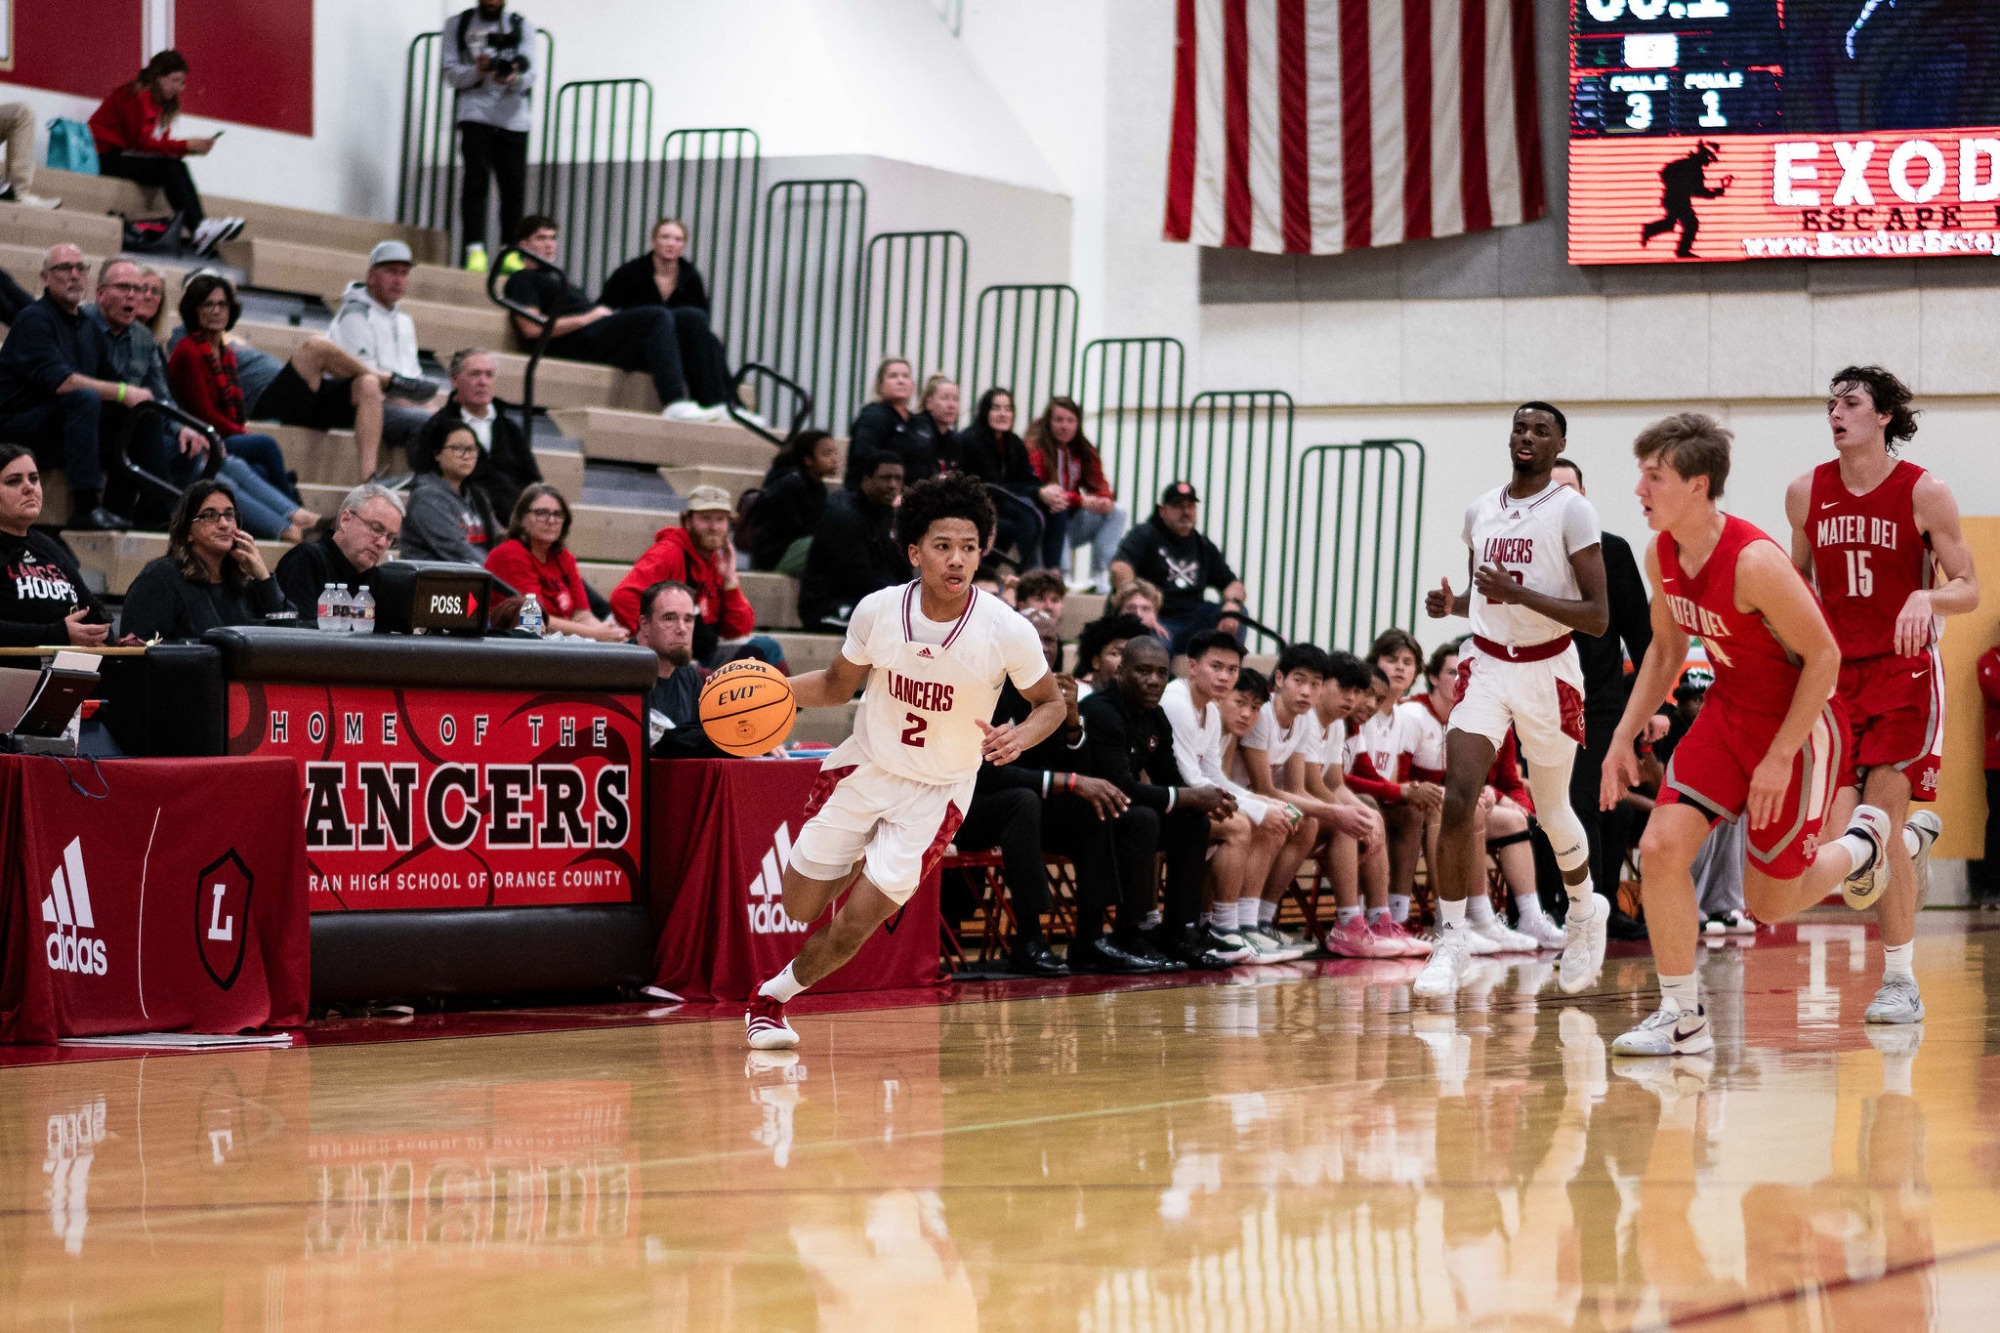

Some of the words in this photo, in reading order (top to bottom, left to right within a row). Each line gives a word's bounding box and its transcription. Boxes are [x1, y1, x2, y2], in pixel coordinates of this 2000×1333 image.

[1625, 92, 1653, 130] 3
[1698, 90, 1728, 127] 1
[1773, 138, 2000, 206] EXOD
[1802, 207, 1962, 231] ESCAPE
[1483, 537, 1533, 564] LANCERS
[1817, 515, 1866, 548] MATER
[1870, 516, 1897, 550] DEI
[1843, 550, 1873, 597] 15
[430, 596, 464, 615] POSS.
[1665, 594, 1699, 632] ATER
[888, 670, 954, 712] LANCERS
[271, 711, 397, 746] HOME
[440, 714, 489, 747] OF
[528, 715, 607, 748] THE
[901, 712, 928, 748] 2
[350, 874, 390, 891] HIGH
[397, 873, 462, 890] SCHOOL
[468, 872, 487, 889] OF
[494, 871, 556, 888] ORANGE
[563, 870, 622, 887] COUNTY
[208, 884, 233, 941] L
[46, 922, 108, 976] adidas
